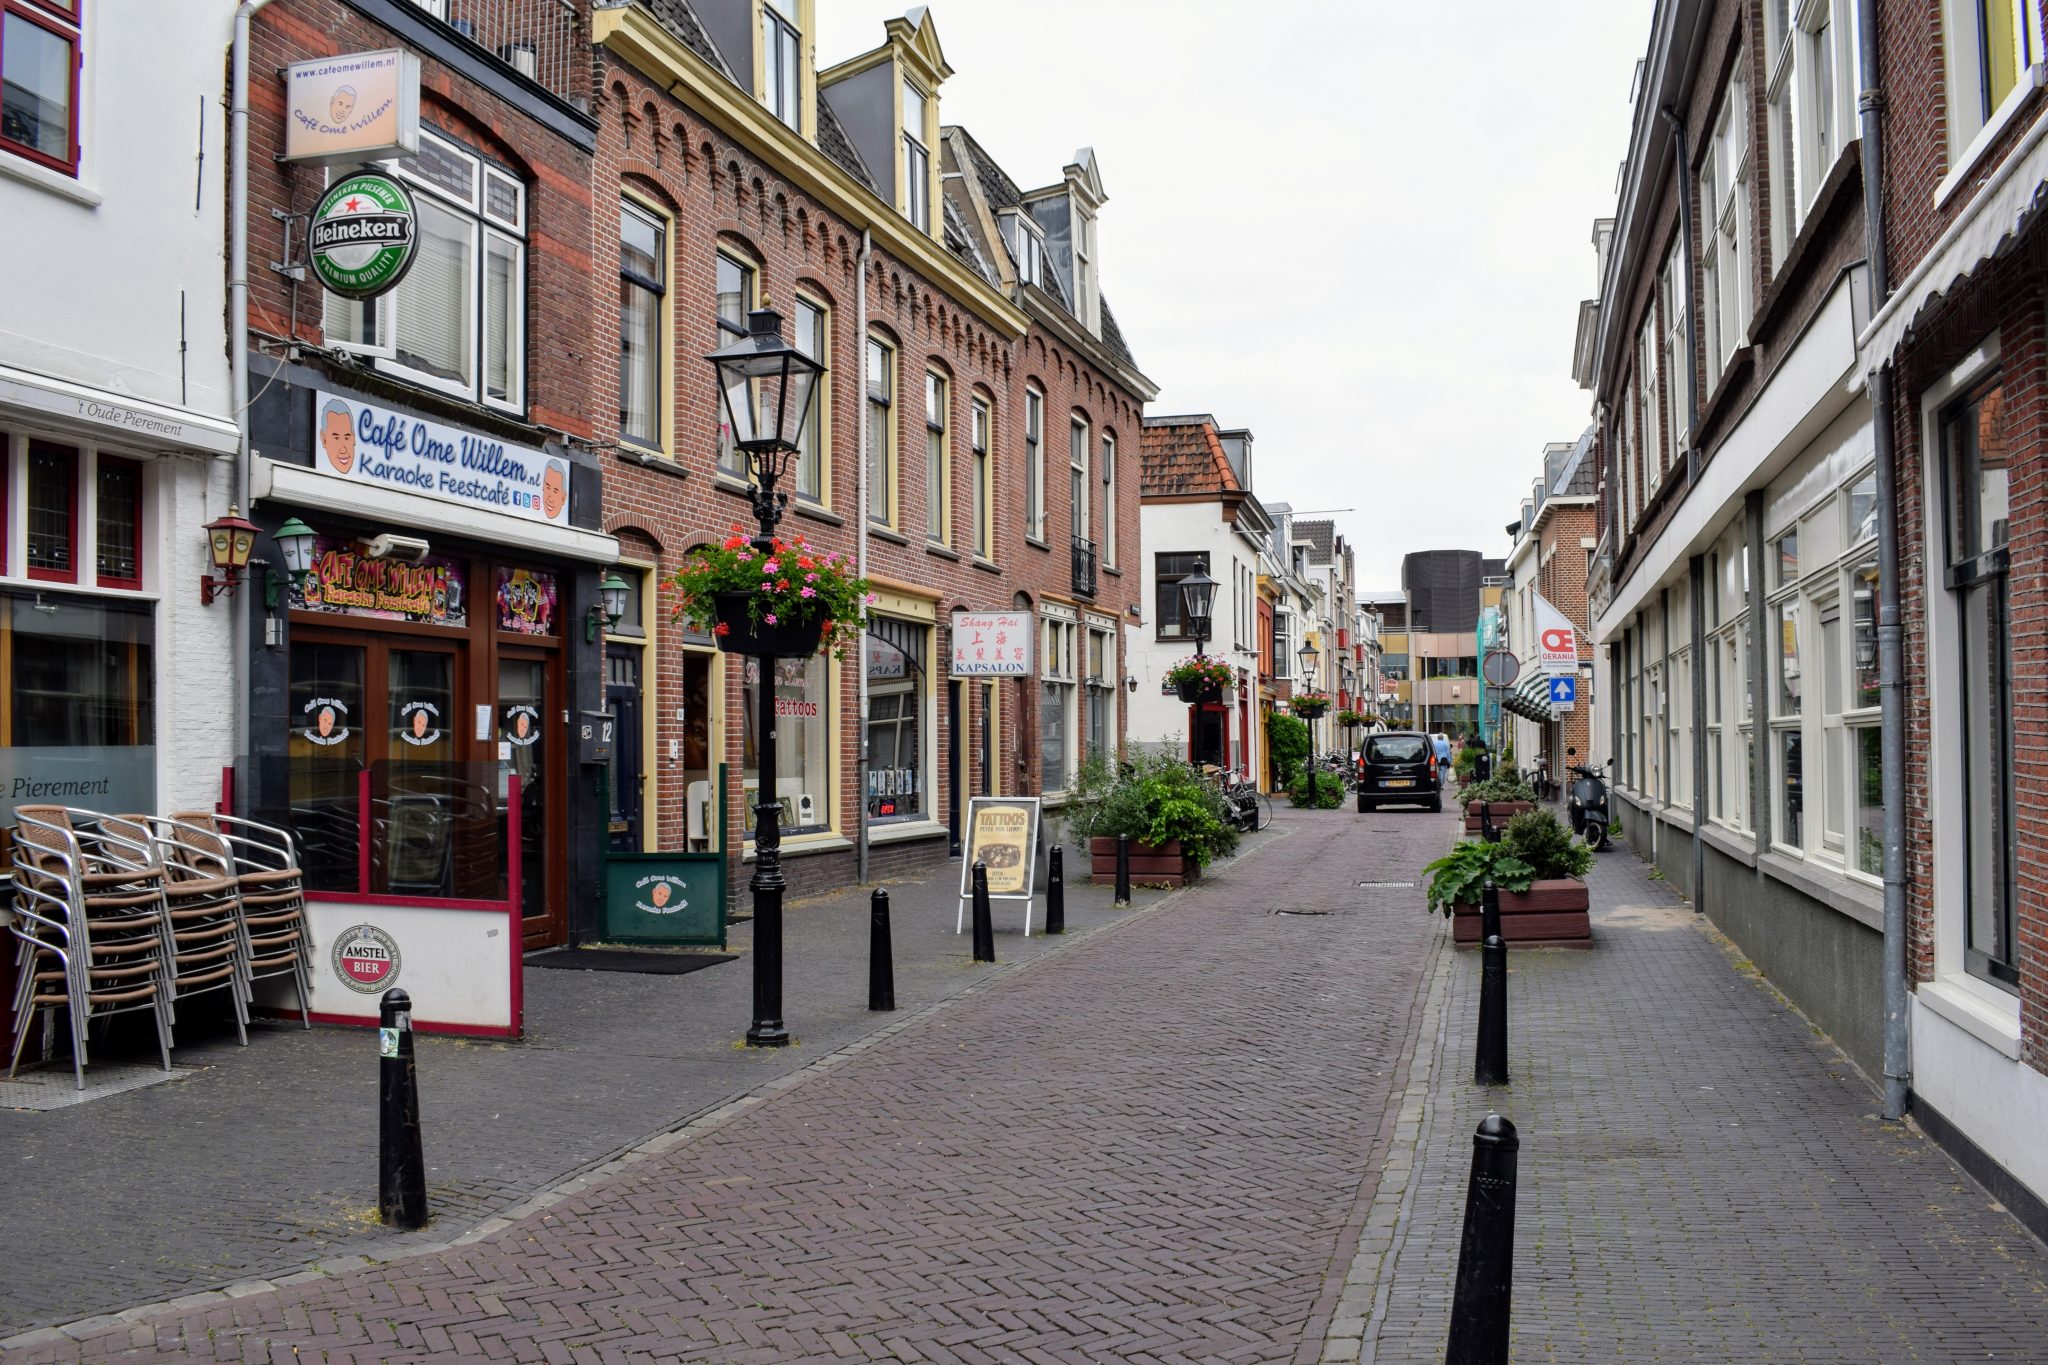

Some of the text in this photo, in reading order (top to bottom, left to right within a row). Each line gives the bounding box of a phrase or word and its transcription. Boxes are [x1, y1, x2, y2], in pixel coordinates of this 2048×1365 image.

[295, 57, 395, 78] www.cafeomewillem.nl
[294, 98, 393, 134] Café Ome Willem
[323, 182, 395, 212] HEINEKEN PILSENER
[315, 219, 400, 245] Heineken
[321, 251, 394, 284] PREMIUM QUALITY
[87, 403, 122, 422] Oude
[122, 411, 182, 436] Pierement
[358, 408, 407, 461] Café
[411, 423, 456, 463] Ome
[358, 453, 511, 505] Karaoke Feestcafé
[355, 559, 387, 592] OME
[324, 583, 375, 607] Karaoke
[960, 616, 1019, 629] Shang Hai
[955, 663, 1024, 672] KAPSALON
[602, 721, 613, 742] 12
[11, 776, 109, 798] Pierement
[980, 812, 1025, 825] TATTOOS
[346, 946, 388, 959] AMSTEL
[353, 961, 380, 974] BIER
